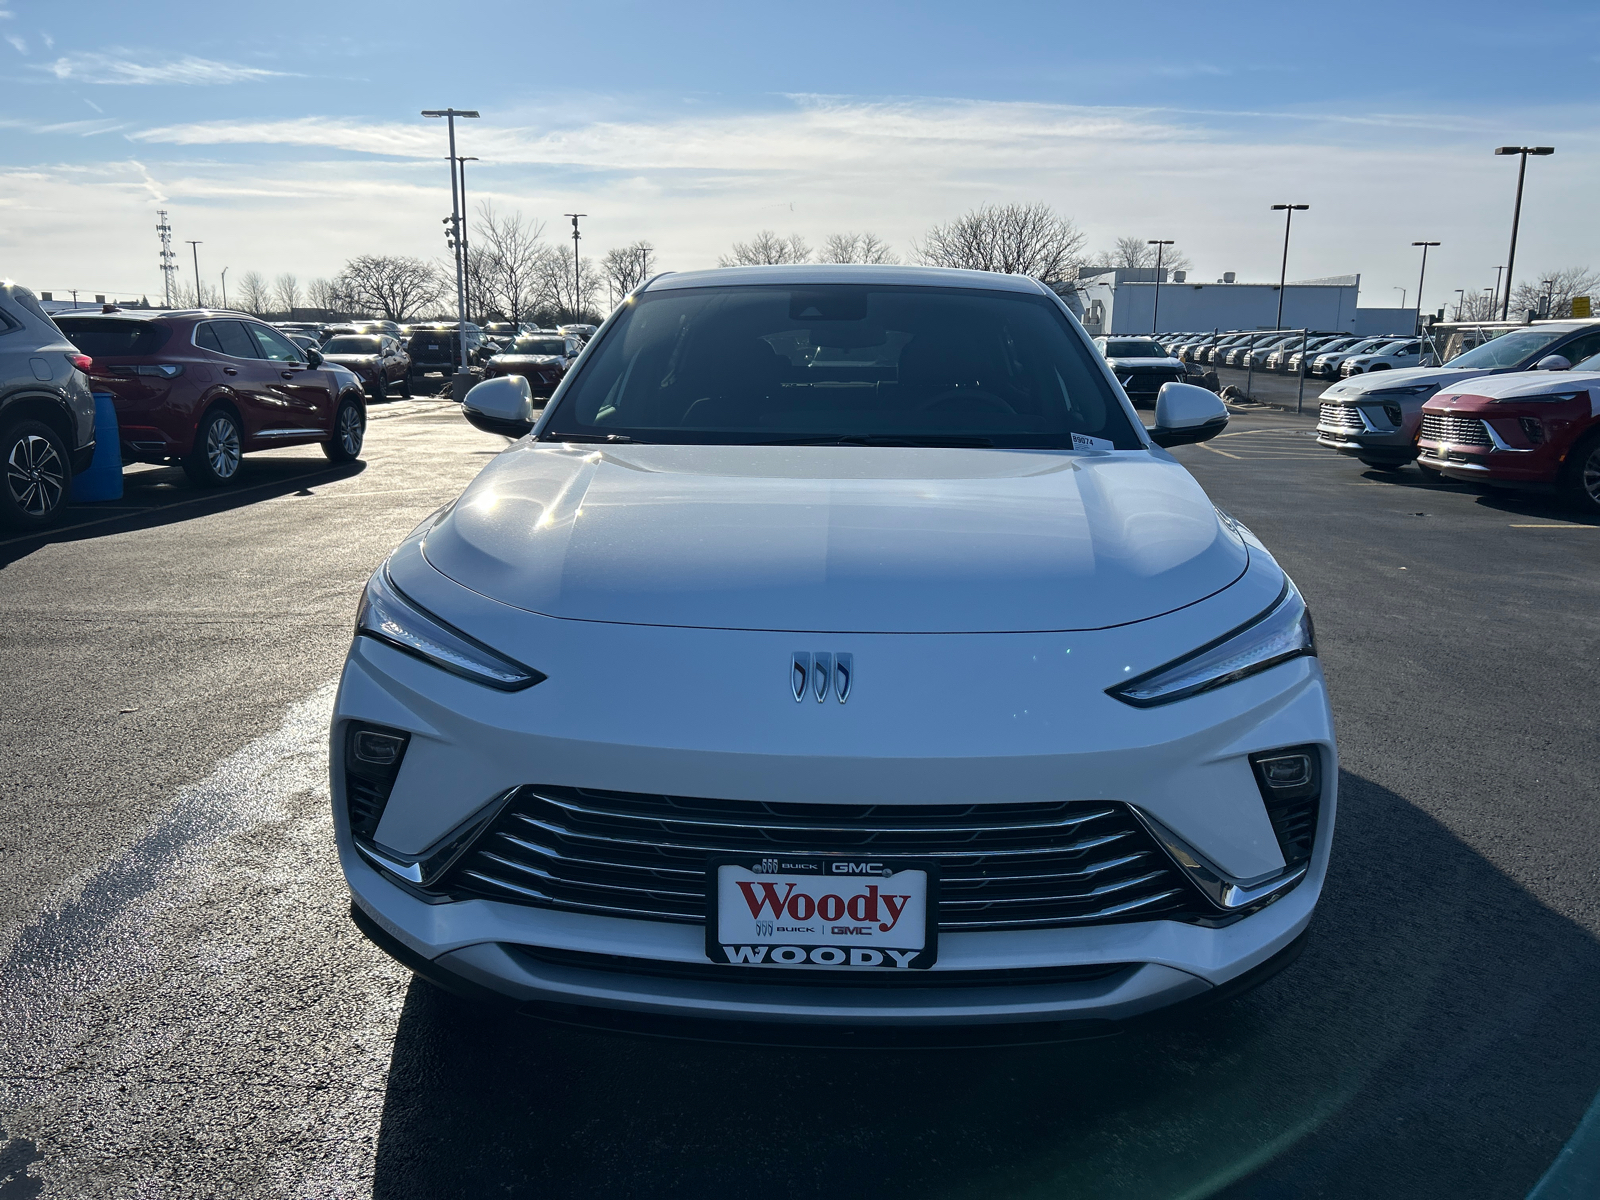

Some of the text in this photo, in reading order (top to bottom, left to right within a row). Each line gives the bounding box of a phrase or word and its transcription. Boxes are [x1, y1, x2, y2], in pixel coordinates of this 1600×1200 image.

[832, 862, 883, 874] GMC
[735, 881, 911, 932] Woody
[831, 926, 872, 935] GMC
[722, 946, 920, 968] WOODY
